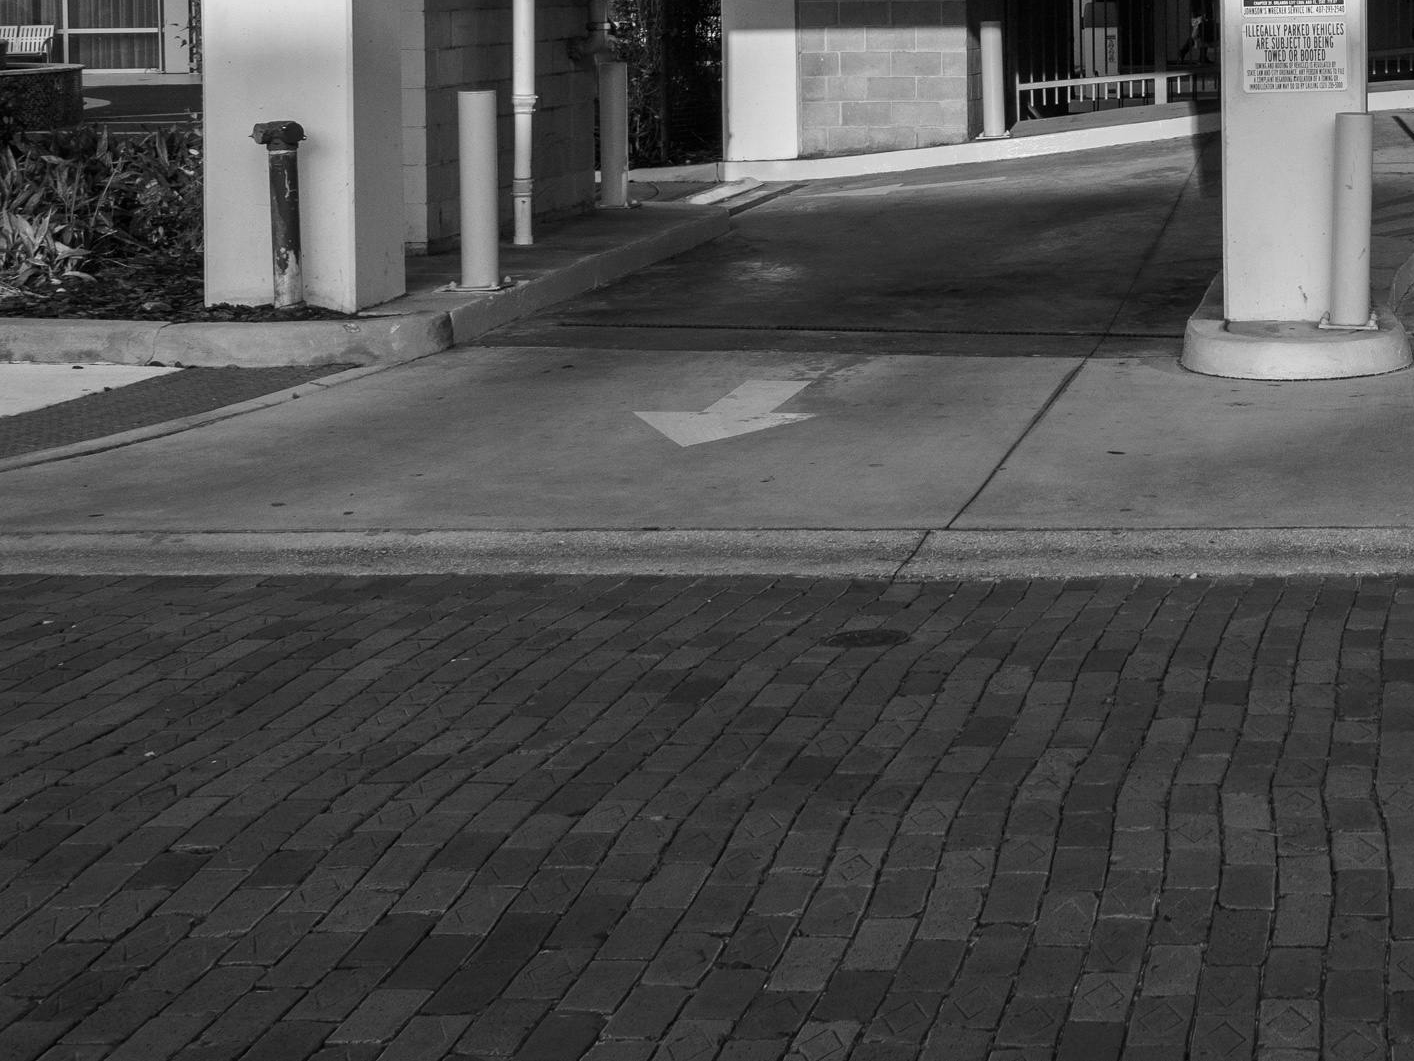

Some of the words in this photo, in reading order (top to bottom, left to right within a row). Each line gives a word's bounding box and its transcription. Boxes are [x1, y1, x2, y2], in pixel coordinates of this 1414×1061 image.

[1246, 25, 1280, 38] ILLEGALLY
[1284, 24, 1309, 36] PARKED
[1312, 23, 1344, 36] VEHICLES
[1256, 37, 1269, 50] ARE
[1272, 37, 1300, 49] SUBJECT
[1303, 36, 1310, 49] TO
[1314, 36, 1334, 48] BEING
[1264, 50, 1286, 62] TOWED
[1289, 49, 1298, 61] OR
[1300, 49, 1325, 61] BOOTED
